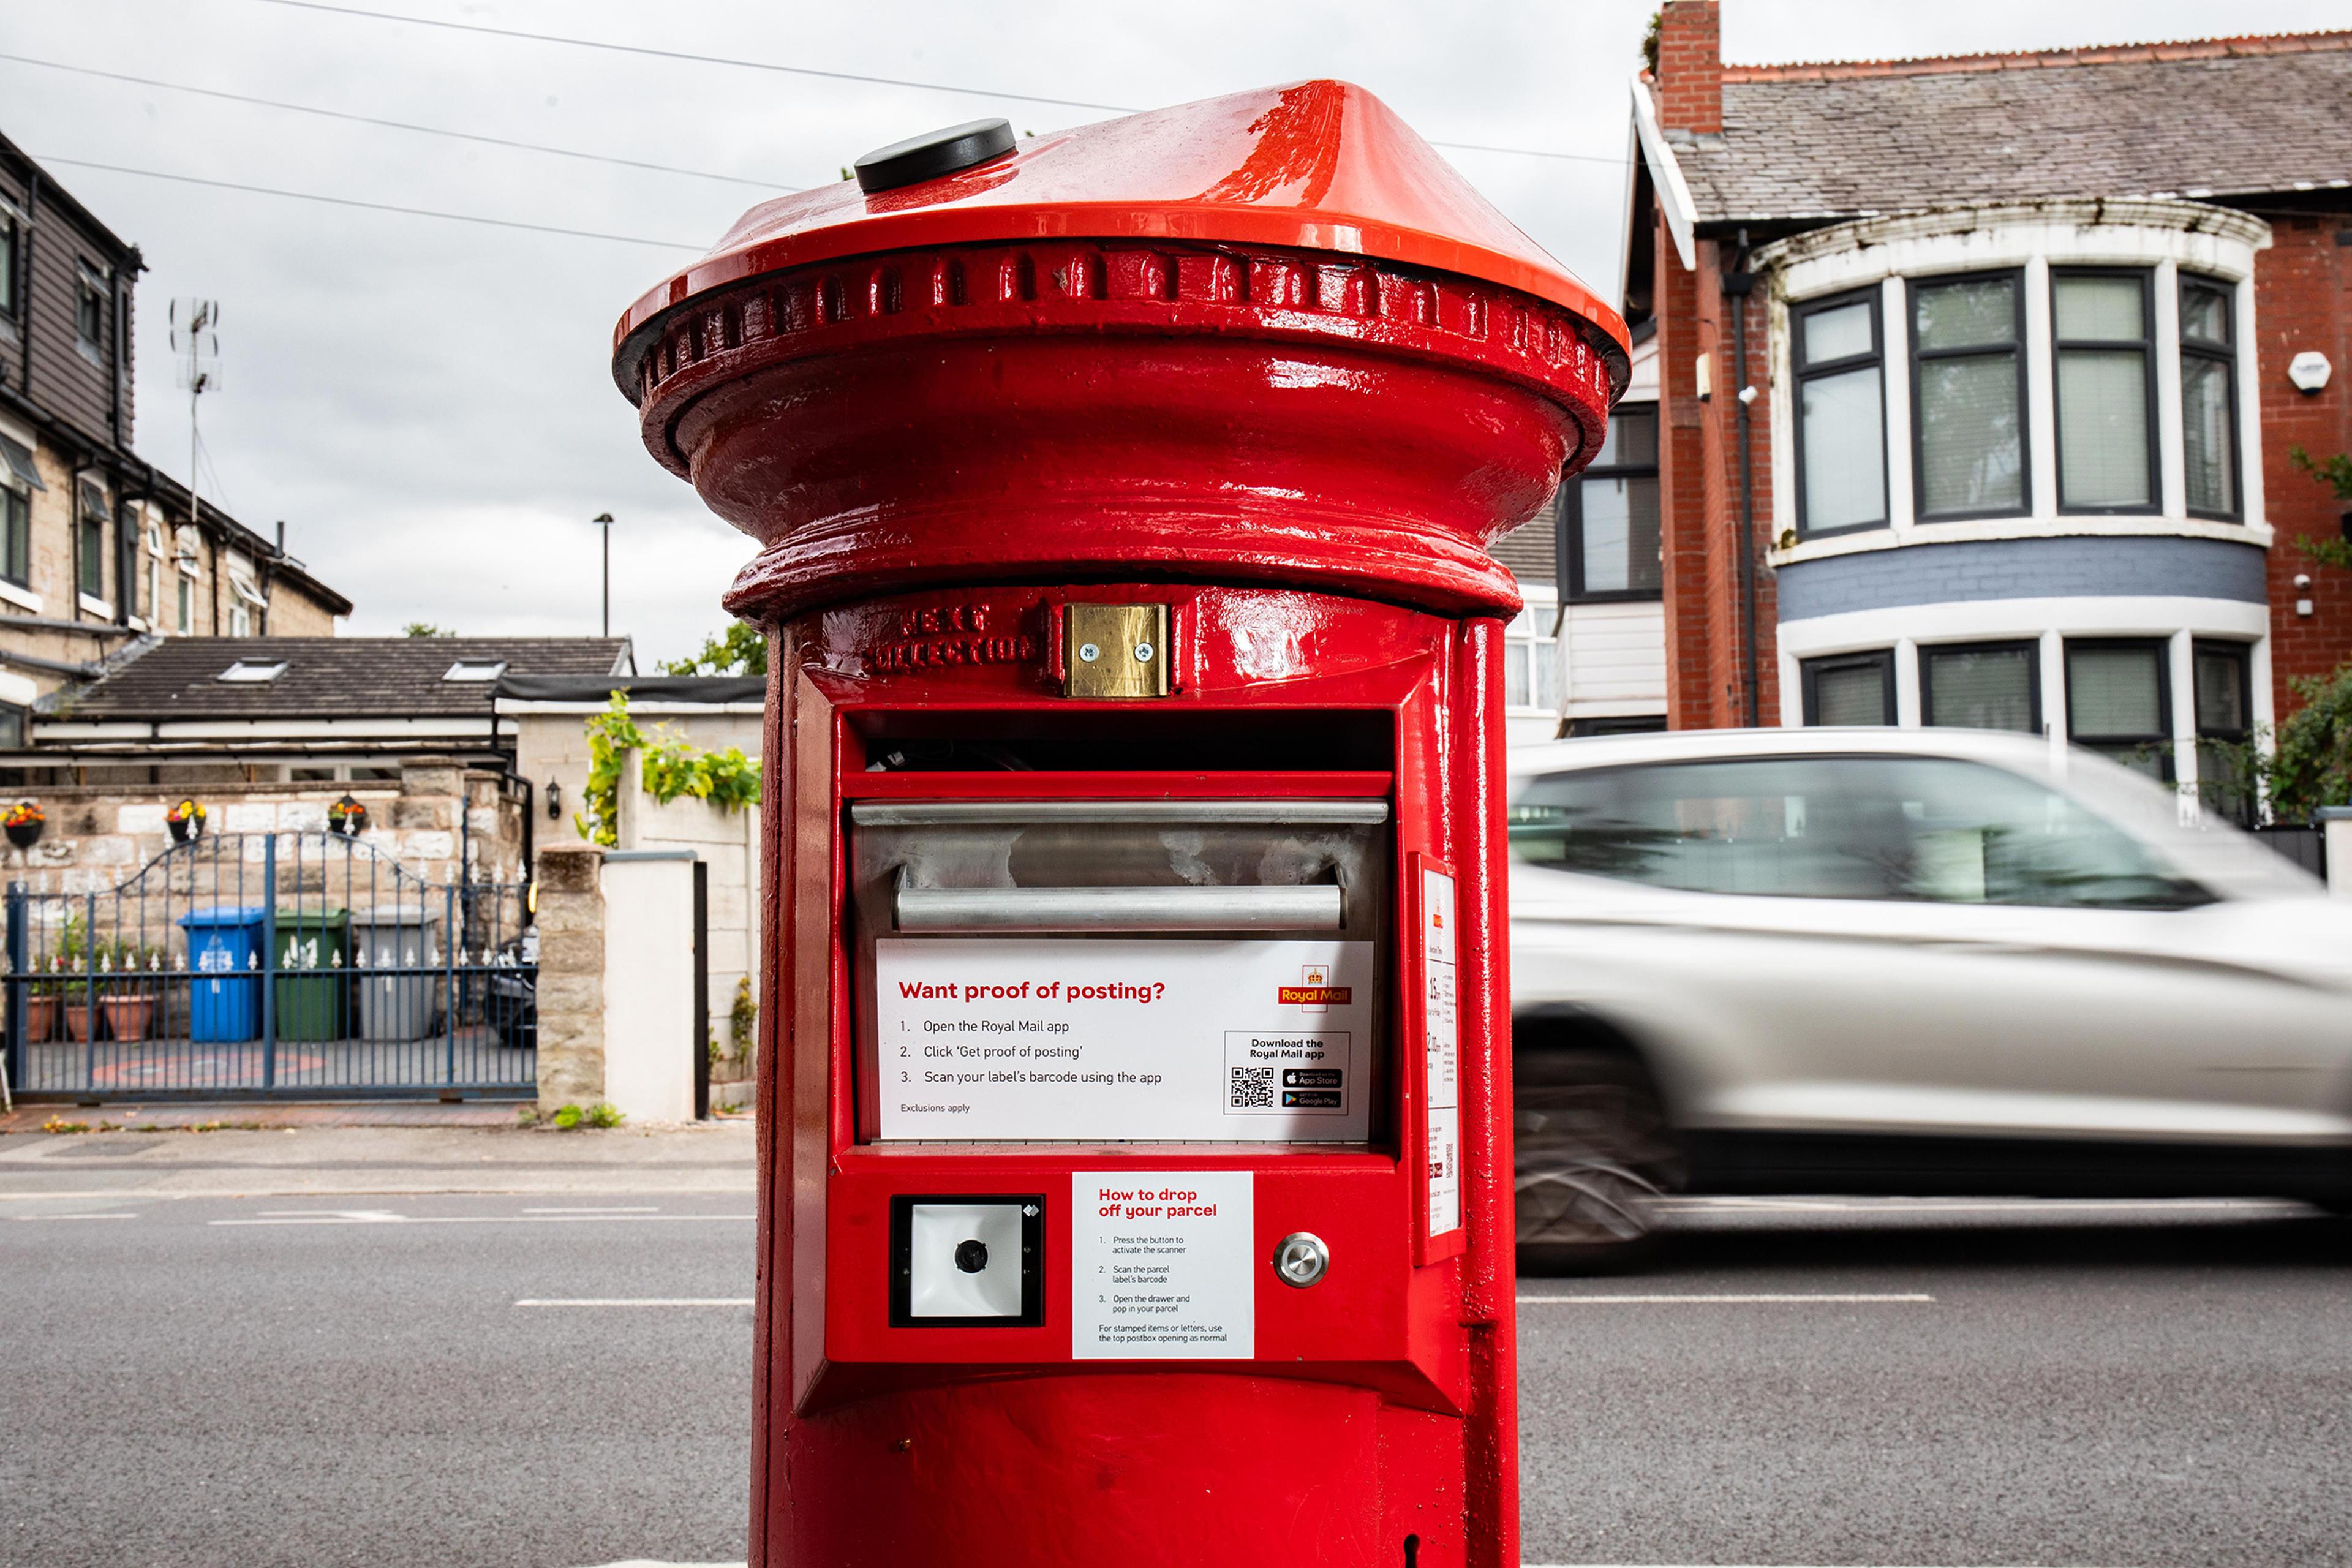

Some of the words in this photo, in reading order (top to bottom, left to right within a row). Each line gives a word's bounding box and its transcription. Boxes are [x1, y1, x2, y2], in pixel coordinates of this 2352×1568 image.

[899, 982, 958, 999] Want
[965, 981, 1030, 1003] proof
[1036, 981, 1060, 999] of
[1067, 982, 1165, 1004] posting?
[1283, 990, 1317, 1003] Royal
[1321, 990, 1348, 1000] Mail
[901, 1020, 910, 1031] 1.
[924, 1020, 954, 1034] Open
[959, 1020, 978, 1031] the
[982, 1020, 1015, 1034] Royal
[1019, 1020, 1044, 1031] Mail
[1047, 1023, 1069, 1034] app
[1252, 1039, 1303, 1047] Download
[1305, 1039, 1323, 1048] the
[900, 1046, 910, 1057] 2.
[924, 1046, 953, 1057] Click
[984, 1046, 1016, 1060] proof
[1019, 1046, 1031, 1057] of
[1250, 1049, 1278, 1060] Royal
[1305, 1050, 1324, 1060] app
[901, 1071, 911, 1082] 3.
[925, 1071, 954, 1082] Scan
[957, 1074, 985, 1085] your
[1030, 1071, 1077, 1082] barcode
[1081, 1071, 1114, 1085] using
[1118, 1071, 1136, 1083] the
[1140, 1075, 1161, 1085] app
[1299, 1077, 1316, 1085] App
[948, 1104, 970, 1114] apply
[1099, 1189, 1134, 1201] How
[1138, 1189, 1155, 1200] to
[1159, 1188, 1197, 1203] drop
[1099, 1204, 1121, 1217] off
[1126, 1207, 1163, 1219] your
[1167, 1203, 1216, 1219] parcel
[1114, 1295, 1133, 1303] Open
[1156, 1305, 1178, 1313] parcel
[1114, 1324, 1146, 1333] stamped
[1127, 1334, 1156, 1343] postbox
